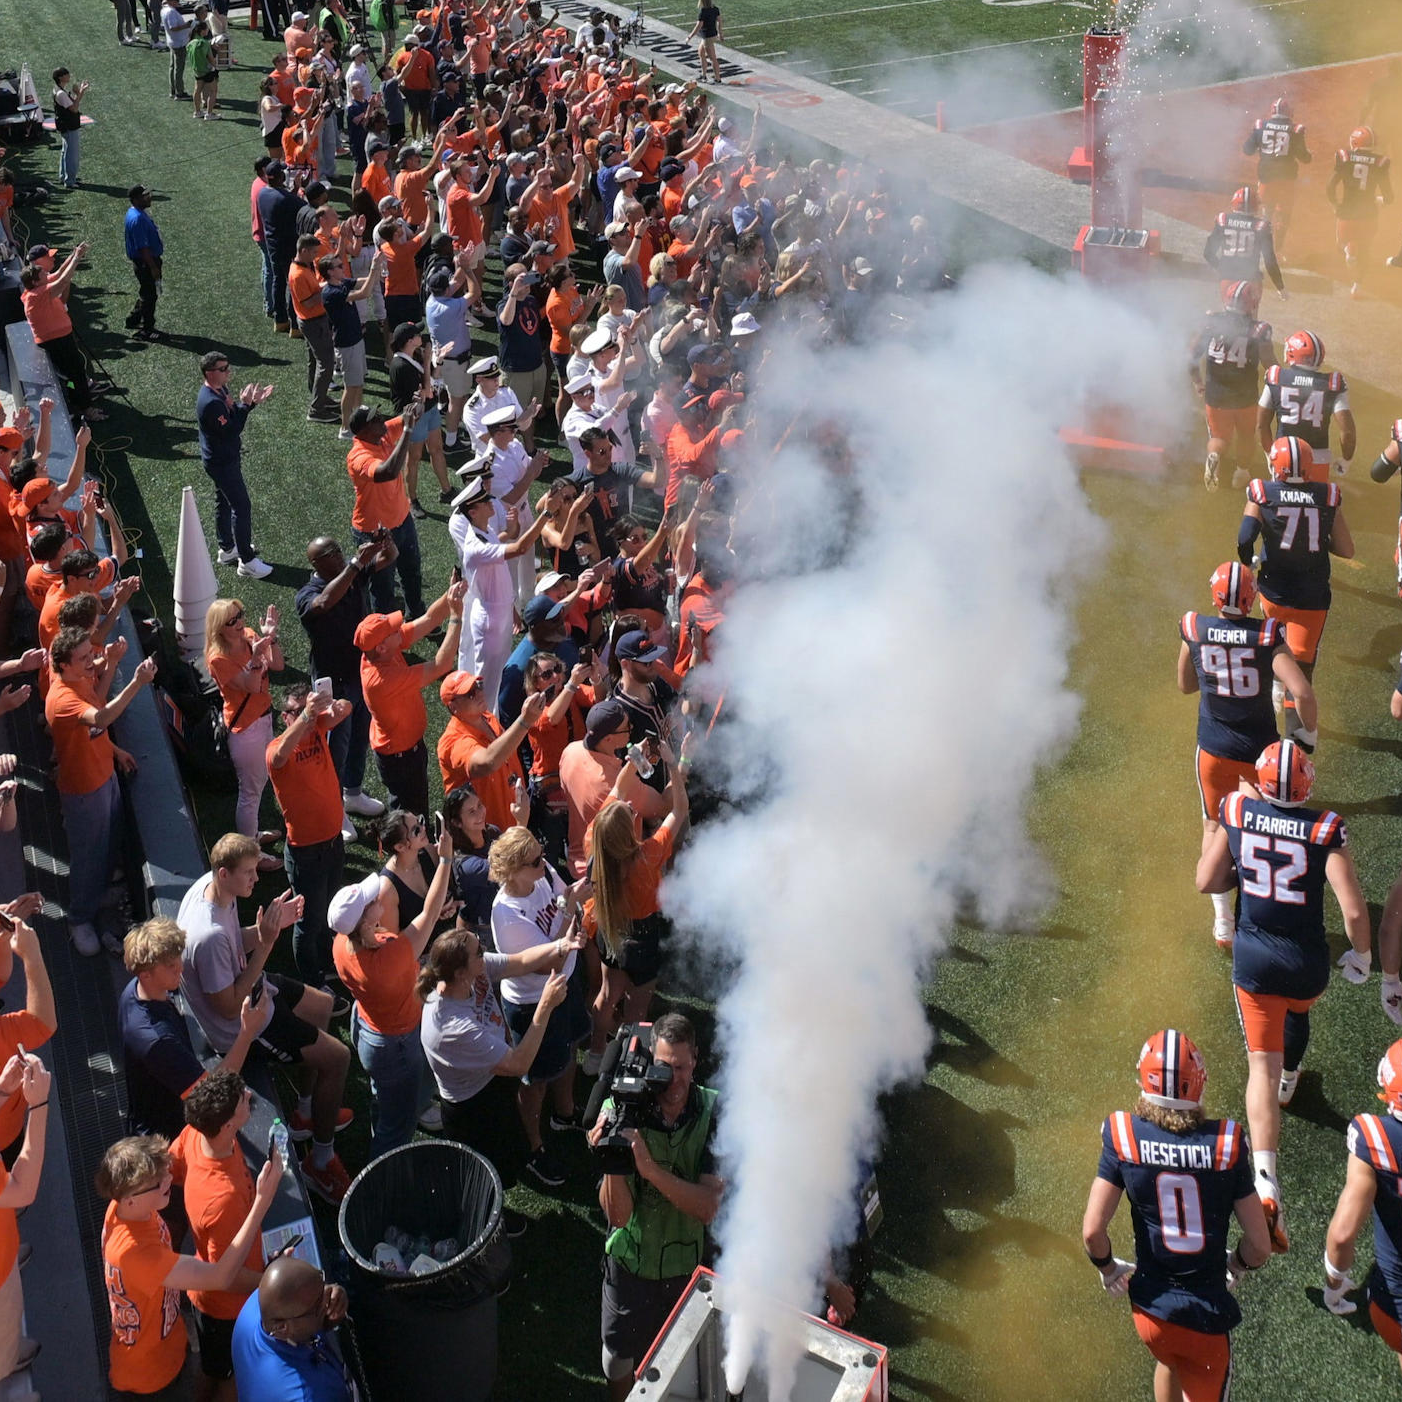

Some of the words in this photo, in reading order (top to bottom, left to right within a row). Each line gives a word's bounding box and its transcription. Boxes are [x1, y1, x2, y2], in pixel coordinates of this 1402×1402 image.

[1261, 129, 1291, 156] 58
[1352, 163, 1369, 191] 9
[1222, 229, 1255, 257] 30
[1207, 334, 1249, 368] 44
[1291, 375, 1314, 387] JOHN
[1280, 386, 1325, 428] 54
[1279, 489, 1315, 505] KNAPIK
[1276, 506, 1321, 552] 71
[1207, 627, 1248, 646] COENEN
[1199, 643, 1261, 698] 96
[1243, 812, 1254, 829] P.
[1256, 813, 1308, 842] FARRELL
[1240, 831, 1308, 905] 52
[1139, 1138, 1213, 1172] RESETICH
[1154, 1170, 1204, 1255] 0
